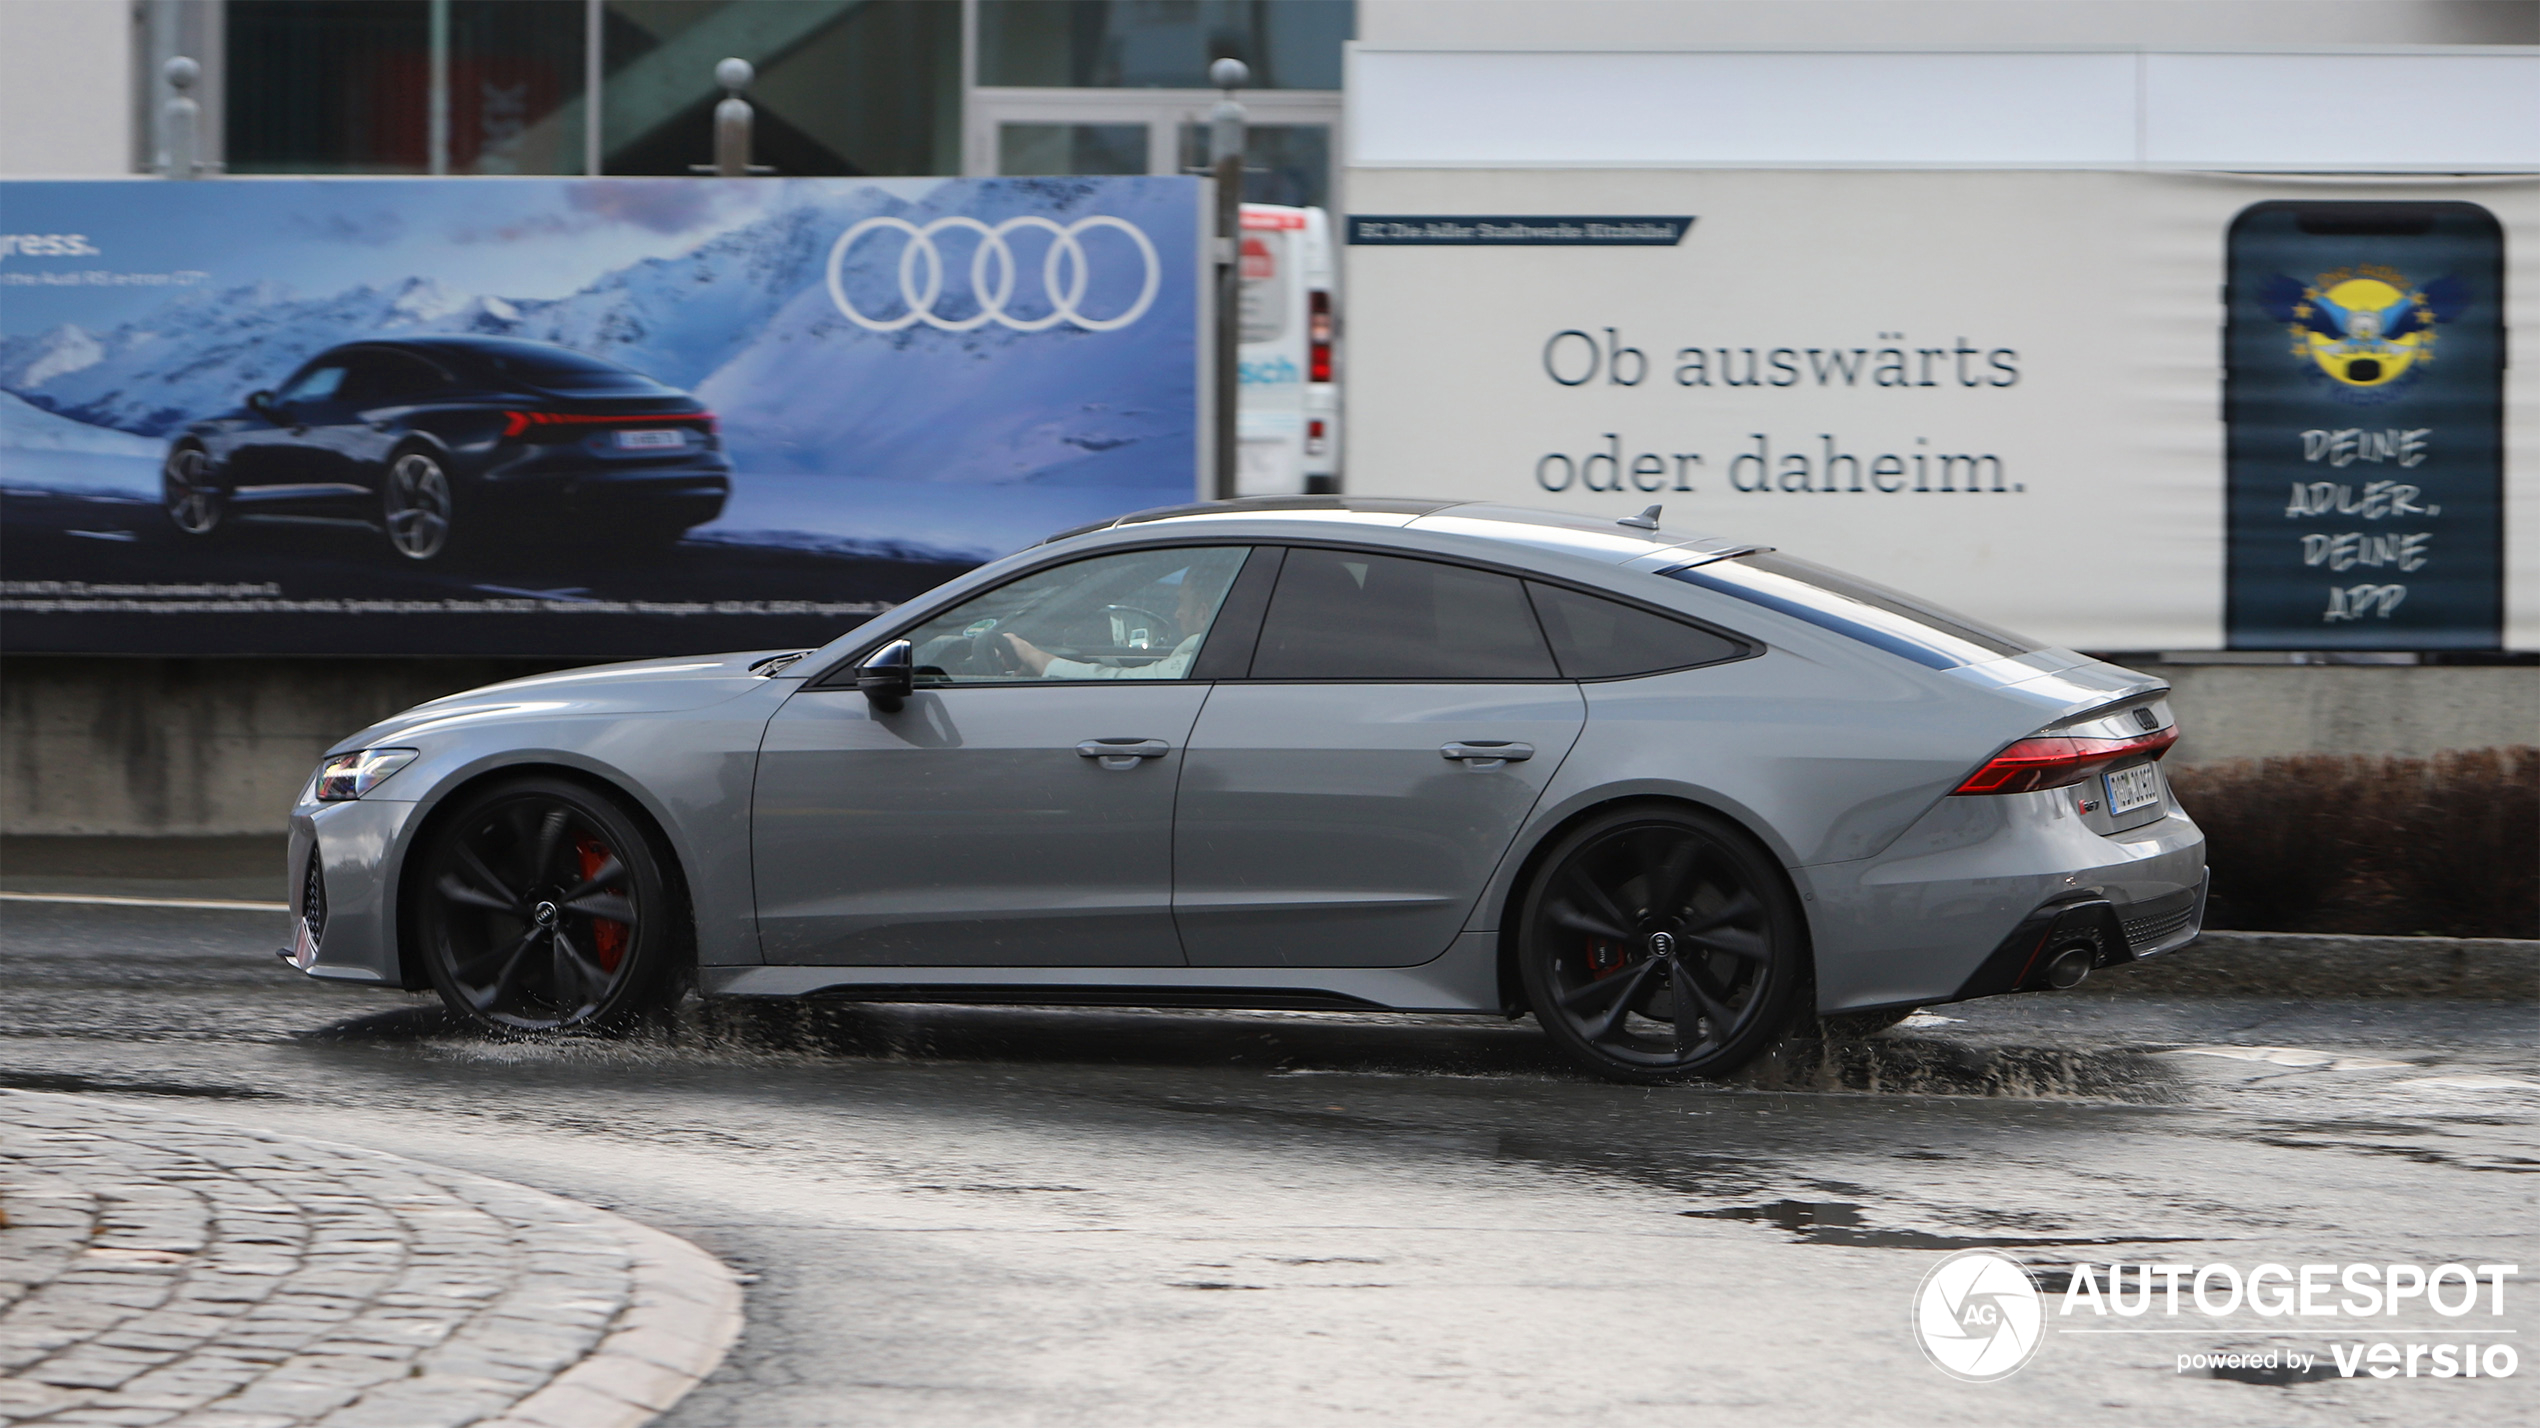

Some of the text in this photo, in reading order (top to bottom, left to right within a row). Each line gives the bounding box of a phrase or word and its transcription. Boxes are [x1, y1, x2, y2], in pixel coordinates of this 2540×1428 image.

[0, 234, 100, 260] ress.
[1238, 355, 1299, 384] sch
[1542, 327, 2021, 388] Ob auswärts
[1535, 433, 2027, 493] oder daheim.
[2300, 428, 2432, 468] DEINE
[2285, 479, 2441, 520] ADLER.
[2300, 532, 2433, 572] DEINE
[2323, 583, 2406, 622] APP
